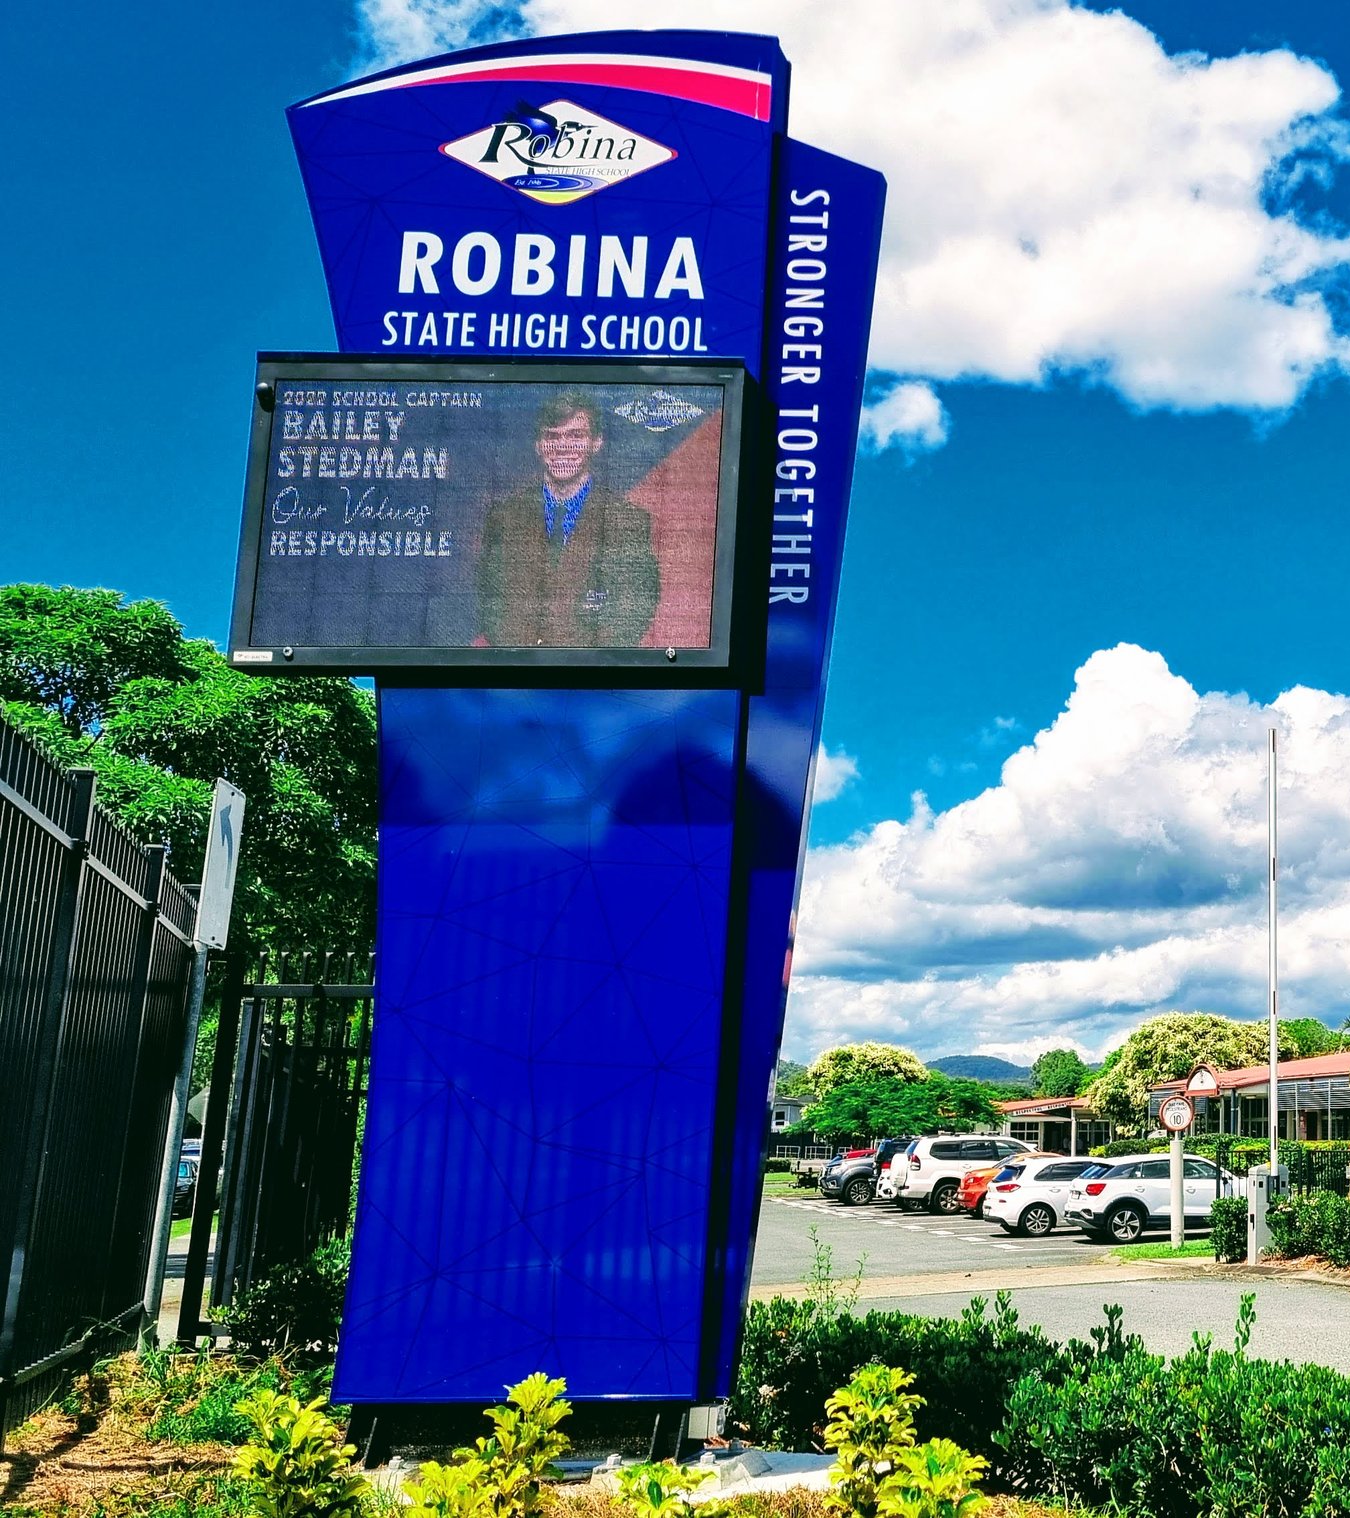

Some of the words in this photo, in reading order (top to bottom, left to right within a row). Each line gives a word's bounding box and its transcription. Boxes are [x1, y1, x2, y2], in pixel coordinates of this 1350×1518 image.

[479, 122, 637, 167] Robina
[398, 231, 705, 300] ROBINA
[780, 189, 831, 385] STRONGER
[381, 311, 477, 347] STATE
[488, 313, 569, 348] HIGH
[580, 315, 708, 351] SCHOOL
[283, 391, 326, 406] 2022
[332, 391, 400, 407] SCHOOL
[406, 392, 482, 408] CAPTAIN
[283, 410, 405, 441] BAILEY
[278, 446, 449, 478] STEDMAN
[271, 486, 327, 524] Our
[340, 486, 434, 526] Values
[768, 404, 819, 604] TOGETHER
[270, 530, 451, 556] RESPONSIBLE
[1173, 1115, 1182, 1125] 10
